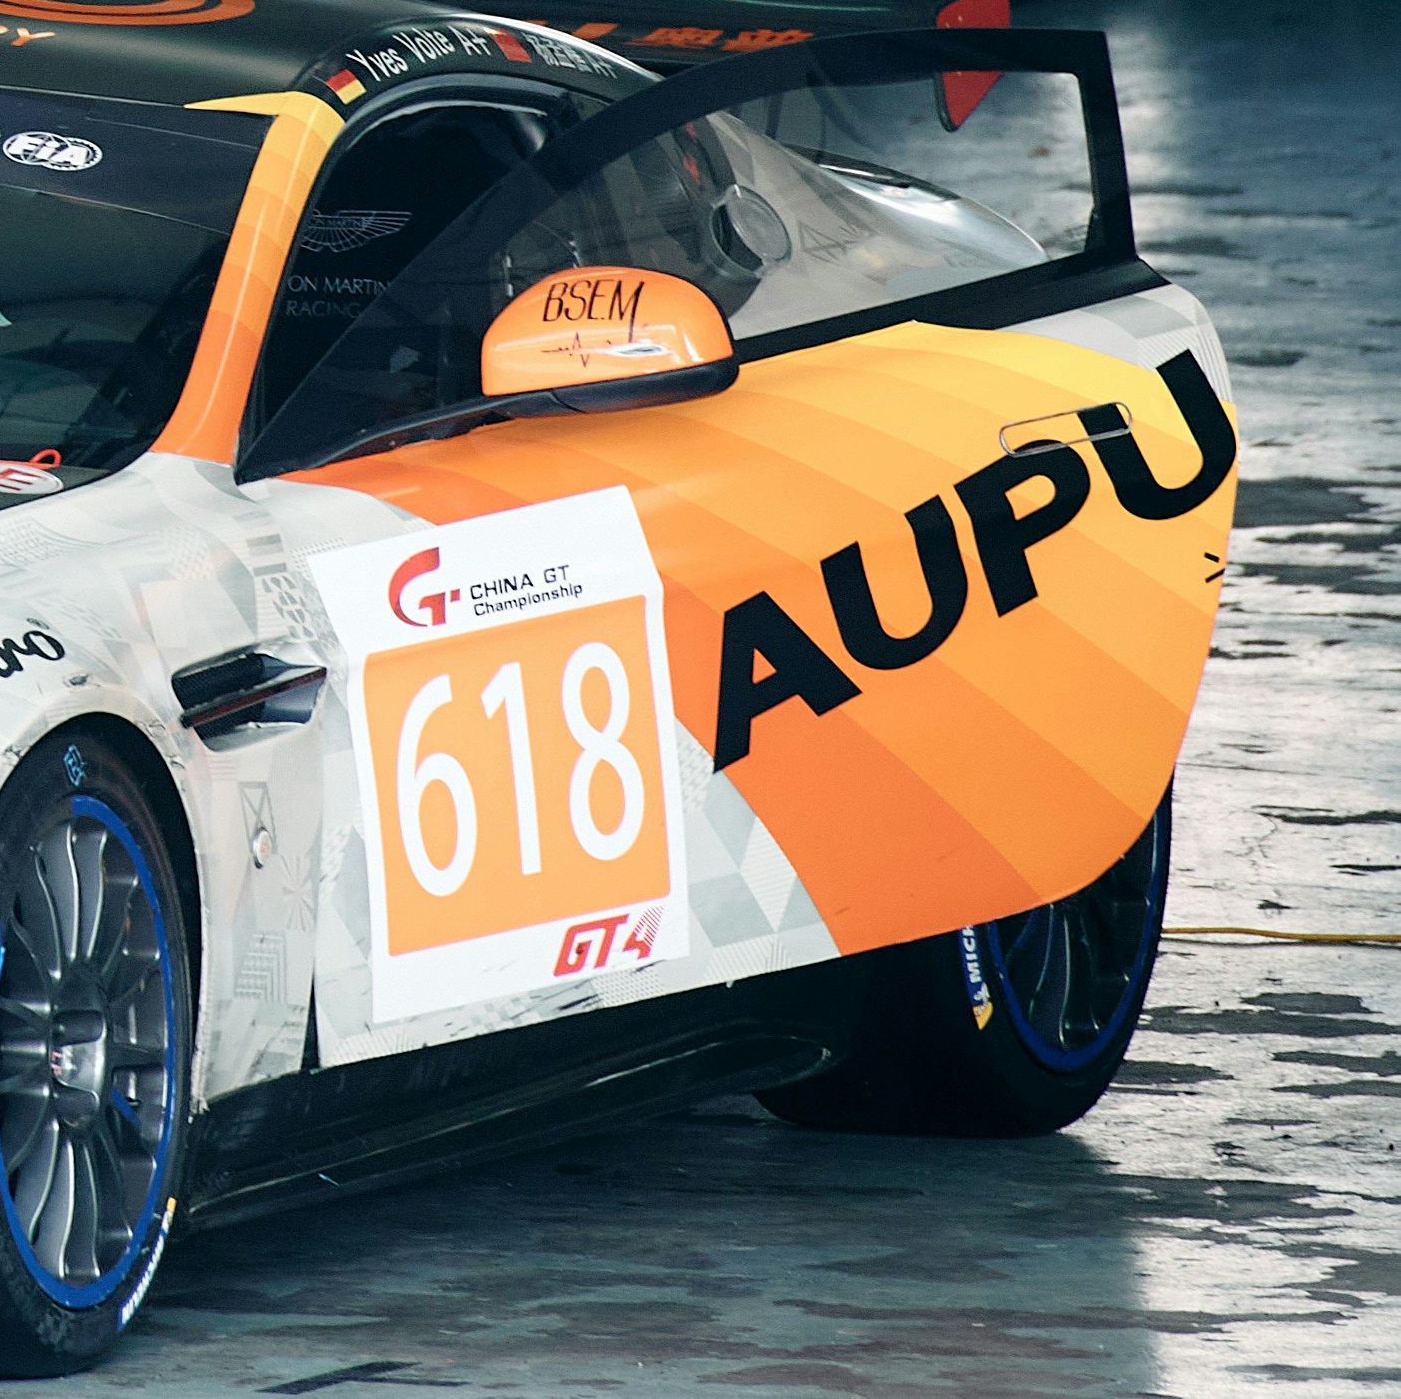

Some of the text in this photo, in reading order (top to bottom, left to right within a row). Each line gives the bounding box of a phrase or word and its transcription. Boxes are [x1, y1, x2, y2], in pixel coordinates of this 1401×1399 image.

[346, 49, 409, 82] Yves
[393, 27, 456, 64] Volte
[448, 25, 491, 56] A+
[543, 278, 645, 343] BSEM
[470, 564, 570, 600] CHINA GT
[713, 349, 1237, 774] AUPU
[473, 583, 583, 617] Championship
[396, 641, 645, 897] 618
[553, 905, 665, 978] GT4
[961, 924, 983, 984] MICH
